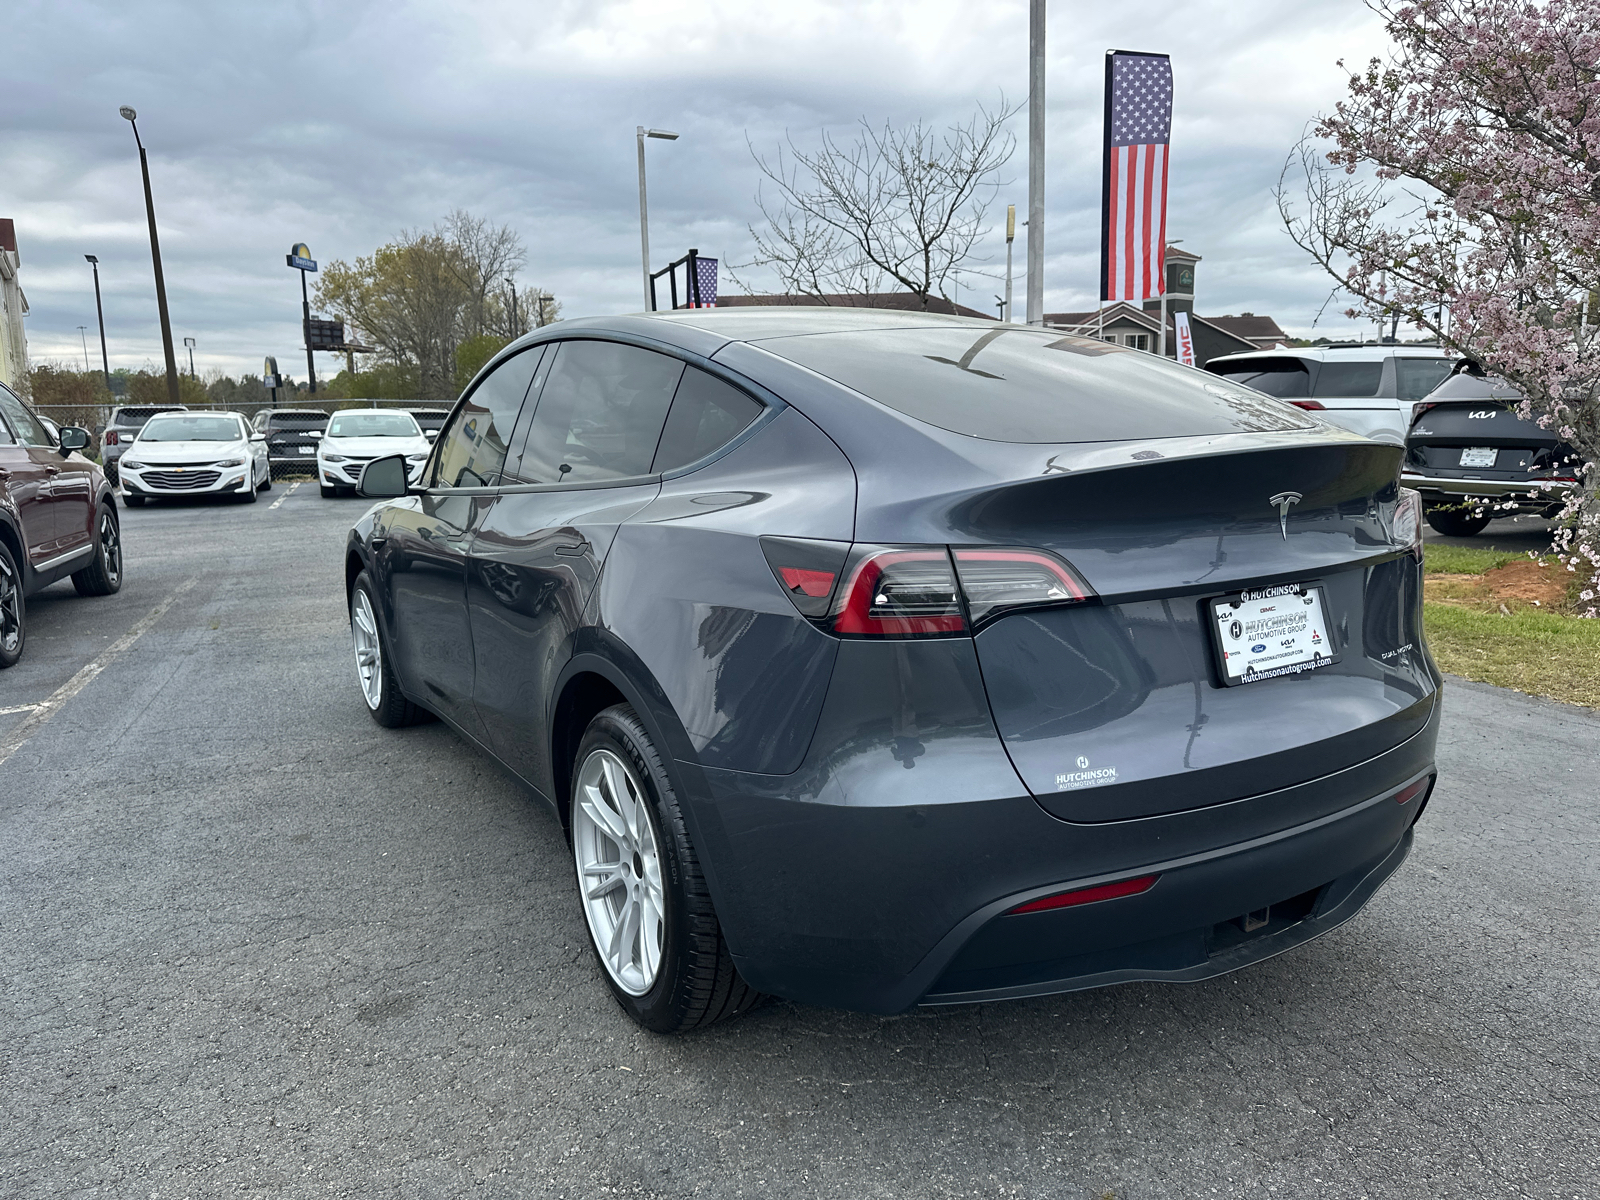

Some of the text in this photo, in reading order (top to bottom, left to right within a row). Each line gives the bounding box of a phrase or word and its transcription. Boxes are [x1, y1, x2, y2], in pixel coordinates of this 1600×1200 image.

[1250, 583, 1300, 600] HUTCHINSON
[1245, 611, 1308, 634] HUTCHINSON
[1248, 624, 1307, 642] AUTOMOTIVE GROUP
[1381, 643, 1413, 660] DUAL MOTOR
[1240, 657, 1332, 684] Hutchinsonautogroup.com
[1056, 767, 1116, 784] HUTCHINSON
[1059, 776, 1116, 790] AUTOMOTIVE GROUP
